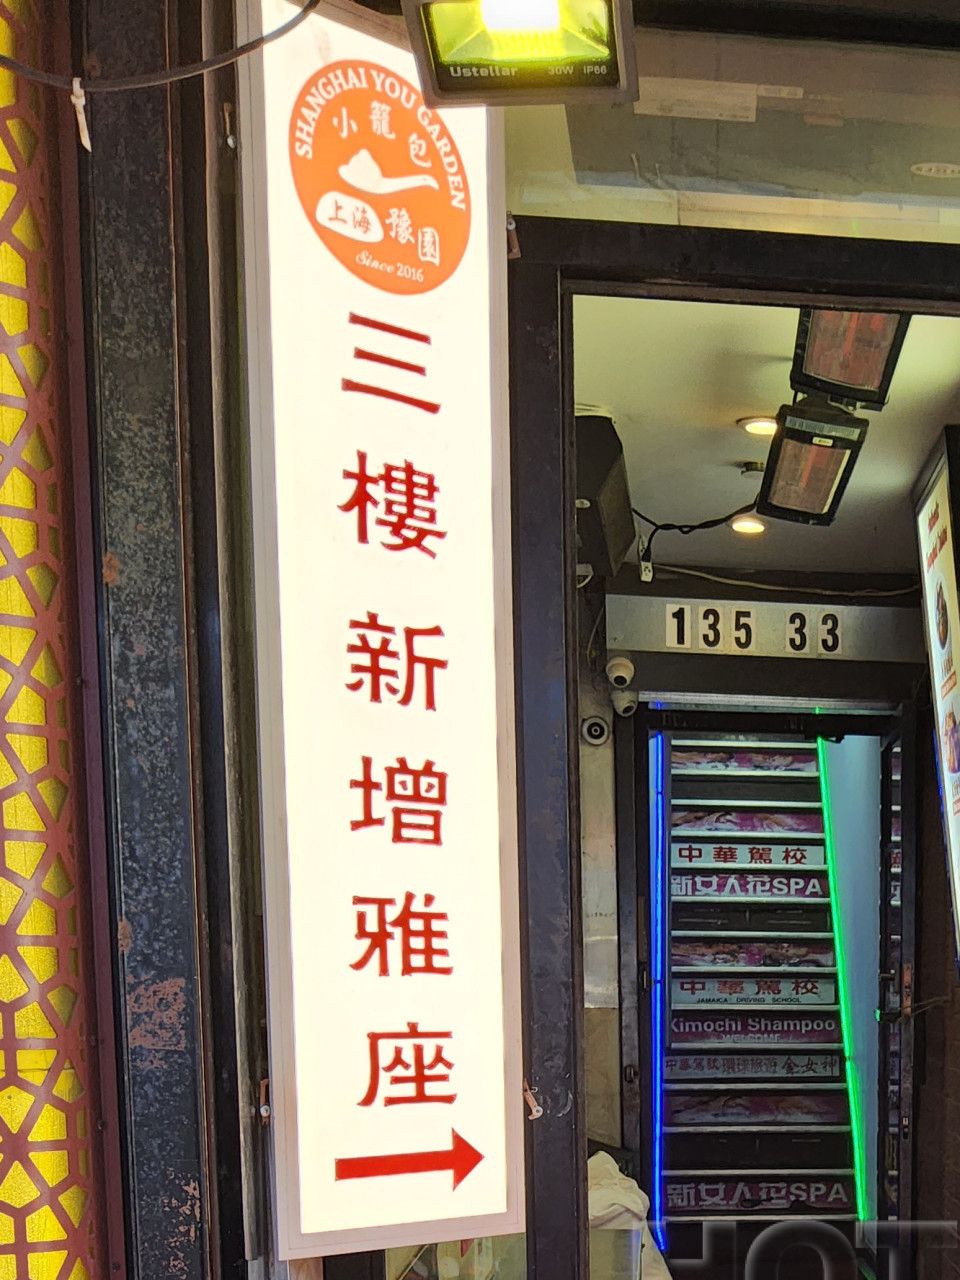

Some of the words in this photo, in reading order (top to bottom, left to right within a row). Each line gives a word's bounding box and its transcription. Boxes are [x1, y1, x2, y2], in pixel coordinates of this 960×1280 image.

[450, 65, 519, 77] Ustellar
[583, 64, 608, 75] IP66
[294, 66, 368, 160] SHANGHAI
[371, 69, 416, 109] YOU
[416, 108, 466, 212] GARDEN
[332, 101, 431, 169] 小籠包
[355, 250, 395, 274] Since
[396, 262, 425, 283] 2016
[671, 606, 753, 650] 135
[788, 612, 840, 653] 33
[337, 311, 458, 1107] 三樓新增雅座
[678, 844, 808, 866] 中華駕校
[679, 979, 819, 996] 中華駕校
[671, 1017, 742, 1033] Kimochi
[748, 1017, 836, 1034] Shampoo
